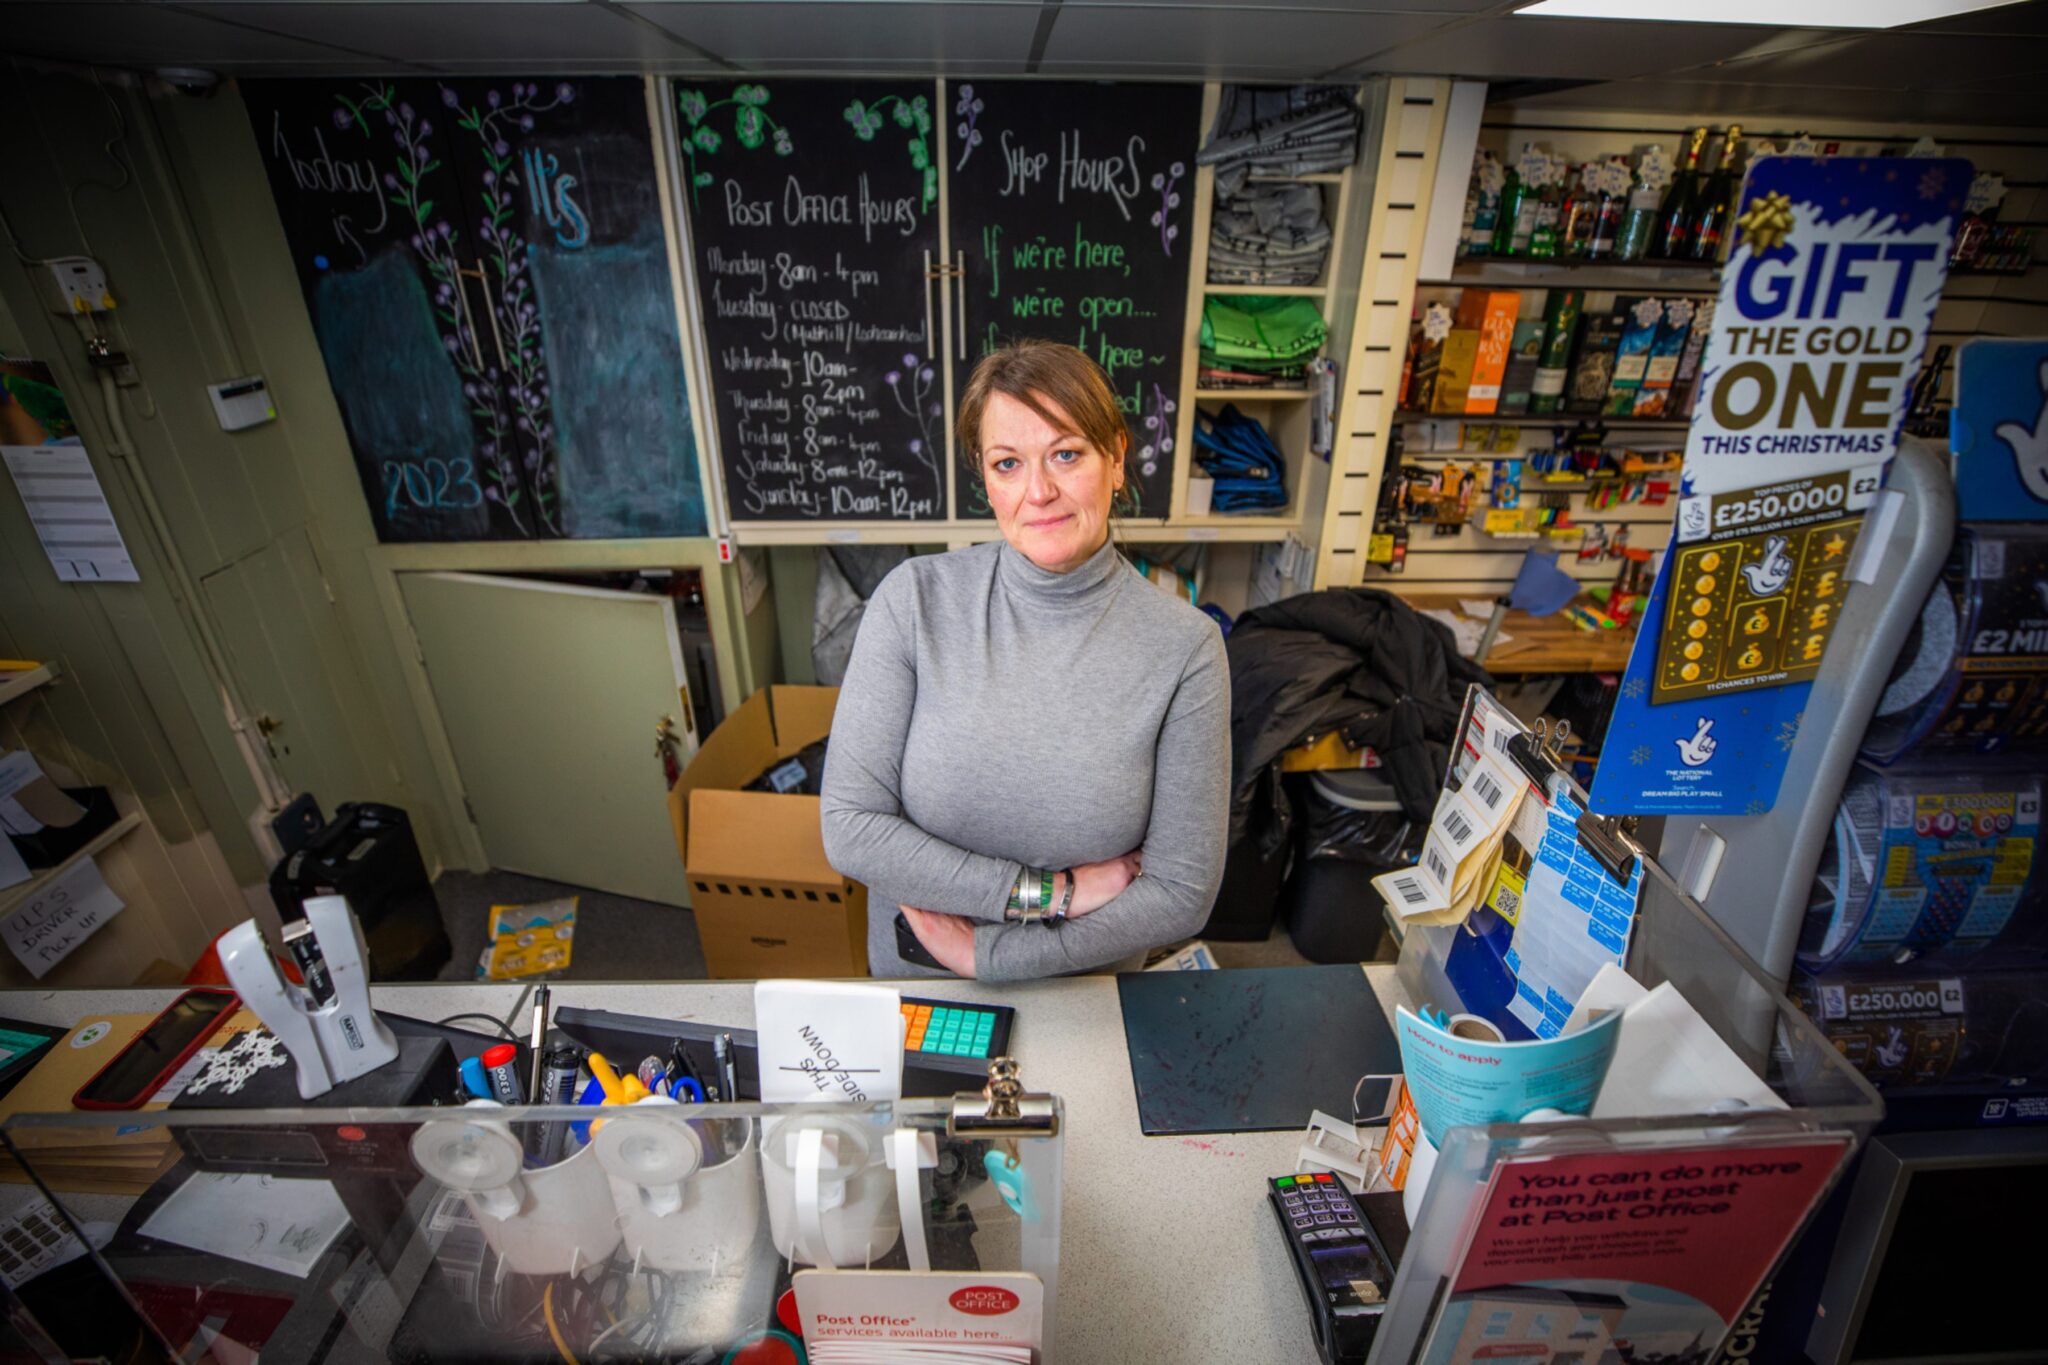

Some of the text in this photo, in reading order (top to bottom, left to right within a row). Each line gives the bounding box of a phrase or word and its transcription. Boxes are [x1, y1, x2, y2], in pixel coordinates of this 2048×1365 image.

[274, 108, 387, 234] Today
[1058, 128, 1146, 221] HOURS
[522, 146, 590, 249] It's
[331, 208, 366, 269] is
[983, 224, 1003, 298] If
[1013, 236, 1067, 270] we're
[1735, 242, 1939, 321] GIFT
[712, 279, 850, 340] Tuesday CLOSED
[1013, 287, 1064, 318] we're
[1726, 326, 1913, 356] THE GOLD
[822, 378, 864, 403] 2pm
[1710, 361, 1904, 431] ONE
[738, 419, 790, 458] Friday
[1701, 433, 1886, 455] THIS CHRISTMAS
[383, 457, 482, 512] 2023
[1854, 477, 1877, 495] £2
[1714, 484, 1844, 528] £250,000
[1972, 629, 2010, 653] £2
[1715, 678, 1755, 690] CHANCES
[22, 907, 78, 953] DRIVER
[1849, 991, 1939, 1011] £250,000
[1407, 1026, 1435, 1047] How
[1439, 1044, 1454, 1056] to
[1458, 1053, 1501, 1066] apply
[798, 1025, 867, 1102] SIDE DOWN
[799, 1058, 831, 1092] THIS
[1518, 1159, 1803, 1190] You can do more
[1509, 1181, 1740, 1209] than just post
[1499, 1200, 1732, 1228] at Post Office
[956, 1300, 1010, 1309] OFFICE
[965, 1292, 1004, 1300] POST
[817, 1315, 851, 1325] Post
[818, 1327, 882, 1337] services
[889, 1328, 957, 1339] available
